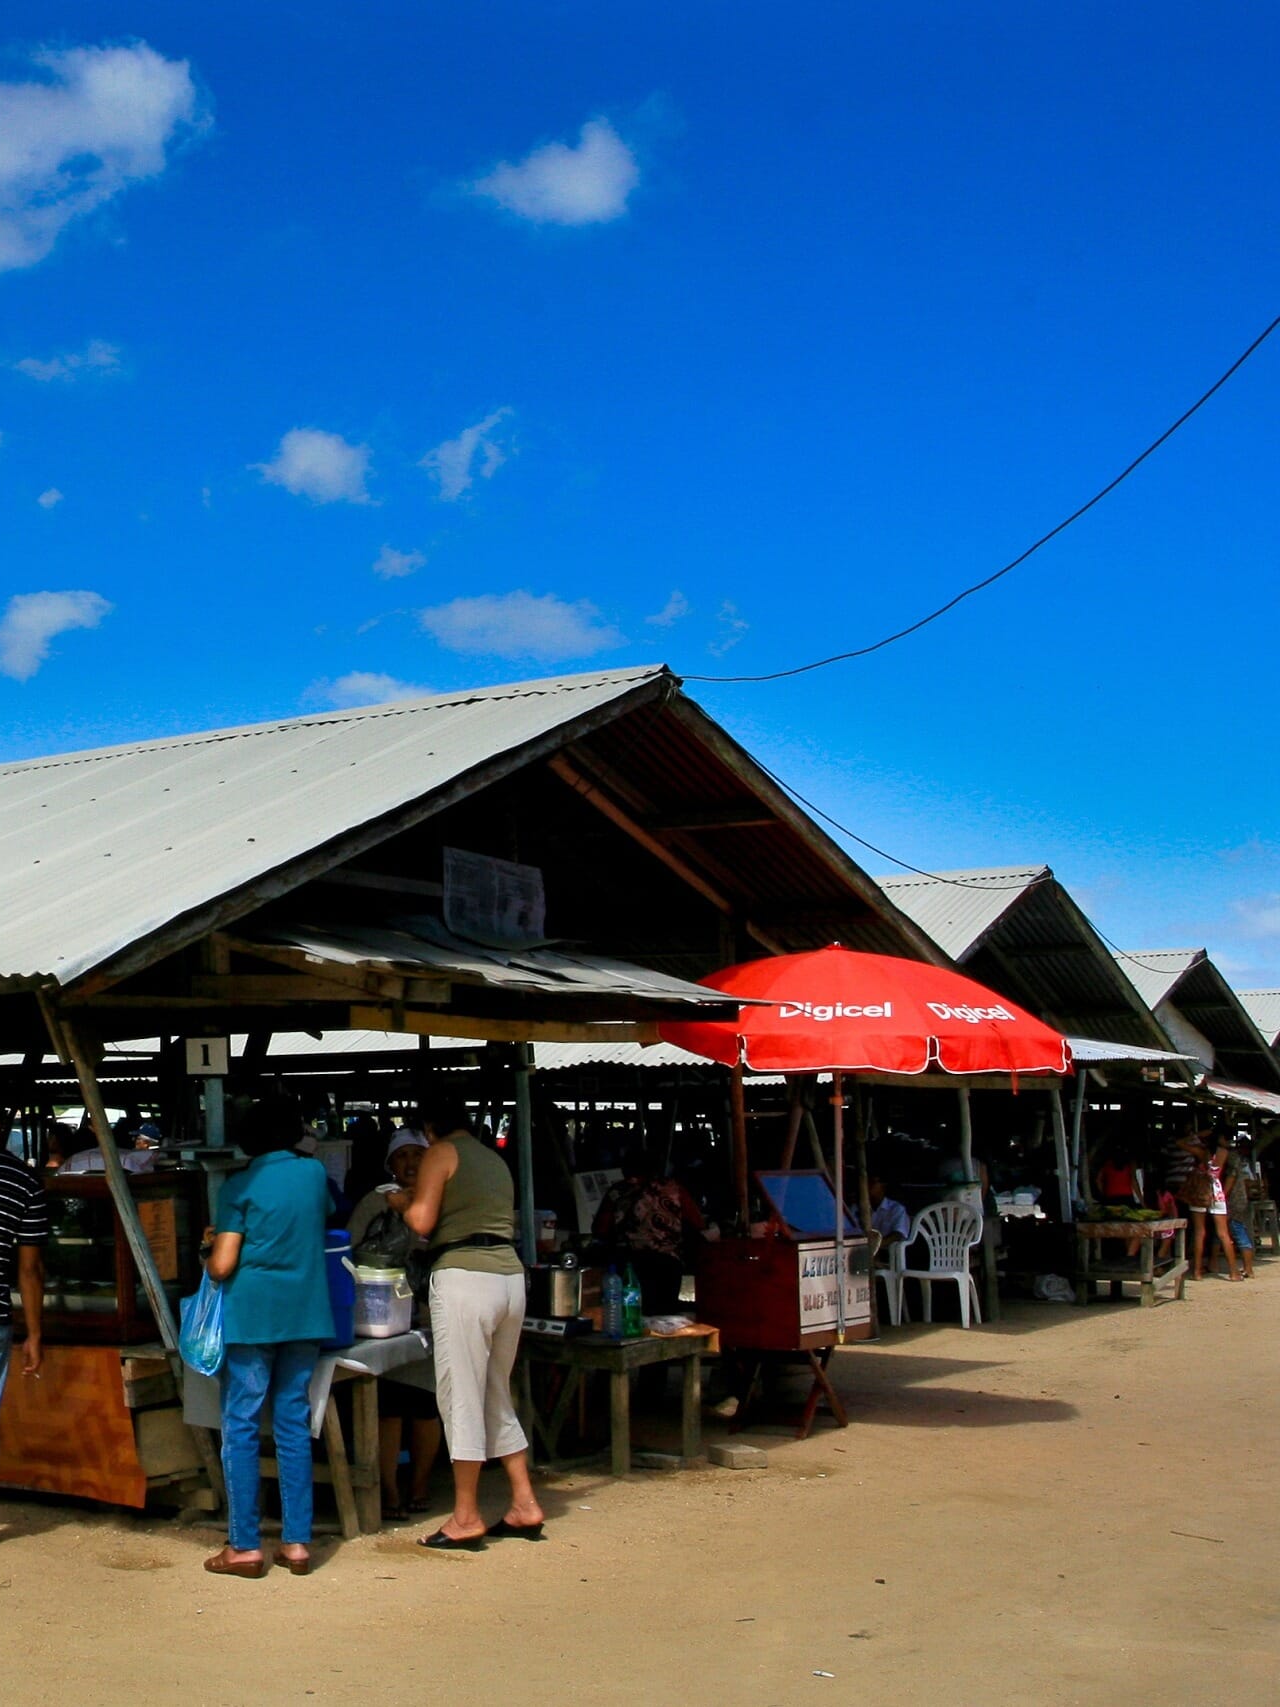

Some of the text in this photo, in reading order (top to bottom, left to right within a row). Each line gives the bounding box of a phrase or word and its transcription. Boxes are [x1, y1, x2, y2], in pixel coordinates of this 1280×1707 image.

[779, 1001, 892, 1022] Digicel
[926, 1002, 1016, 1024] Digicel
[200, 1044, 211, 1066] 1
